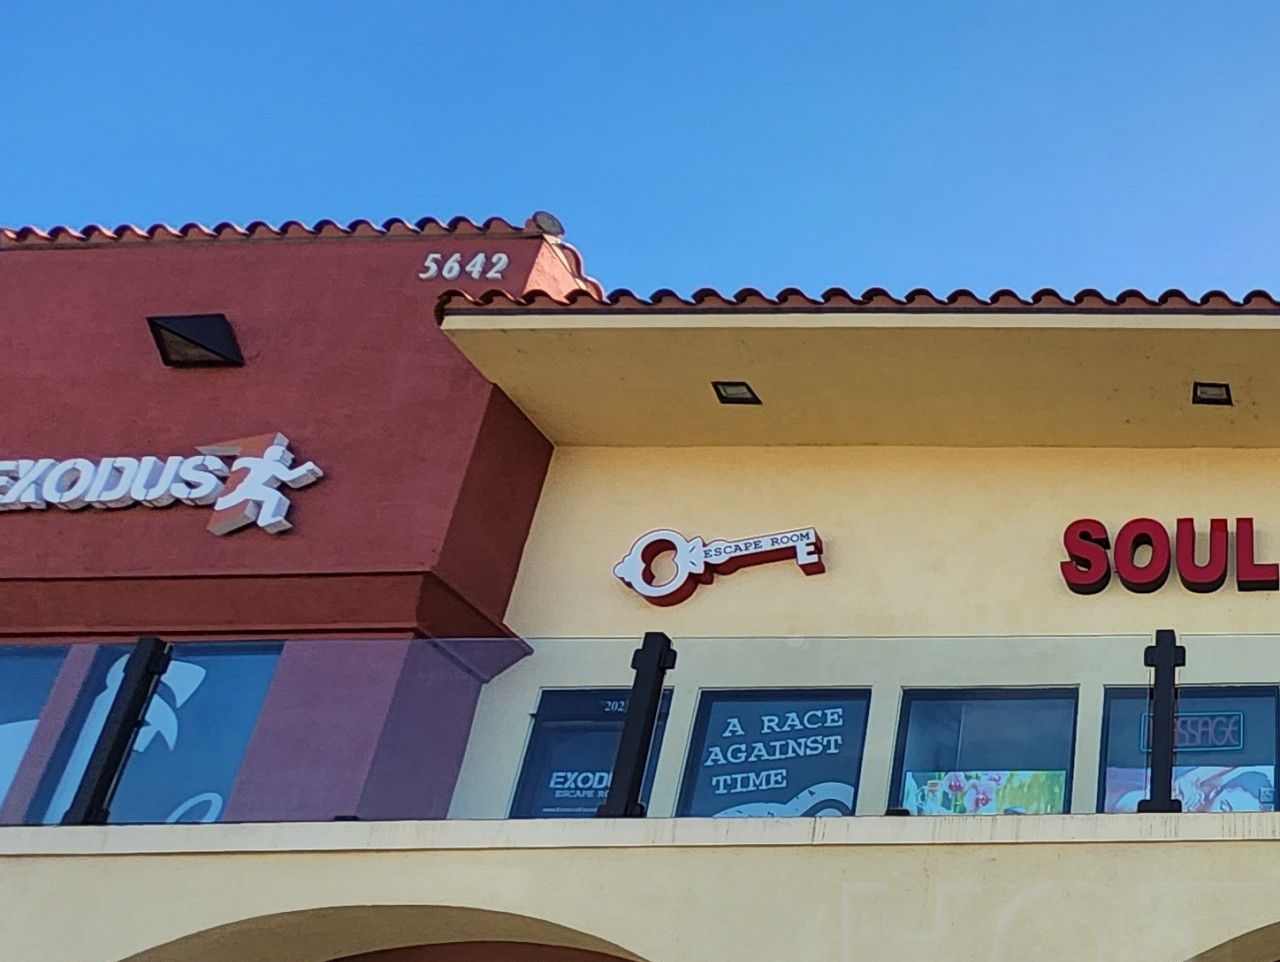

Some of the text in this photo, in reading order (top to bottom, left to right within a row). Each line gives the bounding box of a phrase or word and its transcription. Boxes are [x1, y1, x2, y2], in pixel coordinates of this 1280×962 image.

[419, 252, 509, 280] 5642
[703, 532, 811, 559] ESCAPE ROOM
[1060, 517, 1279, 595] SOUL
[604, 701, 625, 712] 202
[722, 708, 844, 737] A RACE
[704, 735, 844, 767] AGAINST
[555, 789, 594, 798] ESCAPE
[711, 768, 788, 795] TIME
